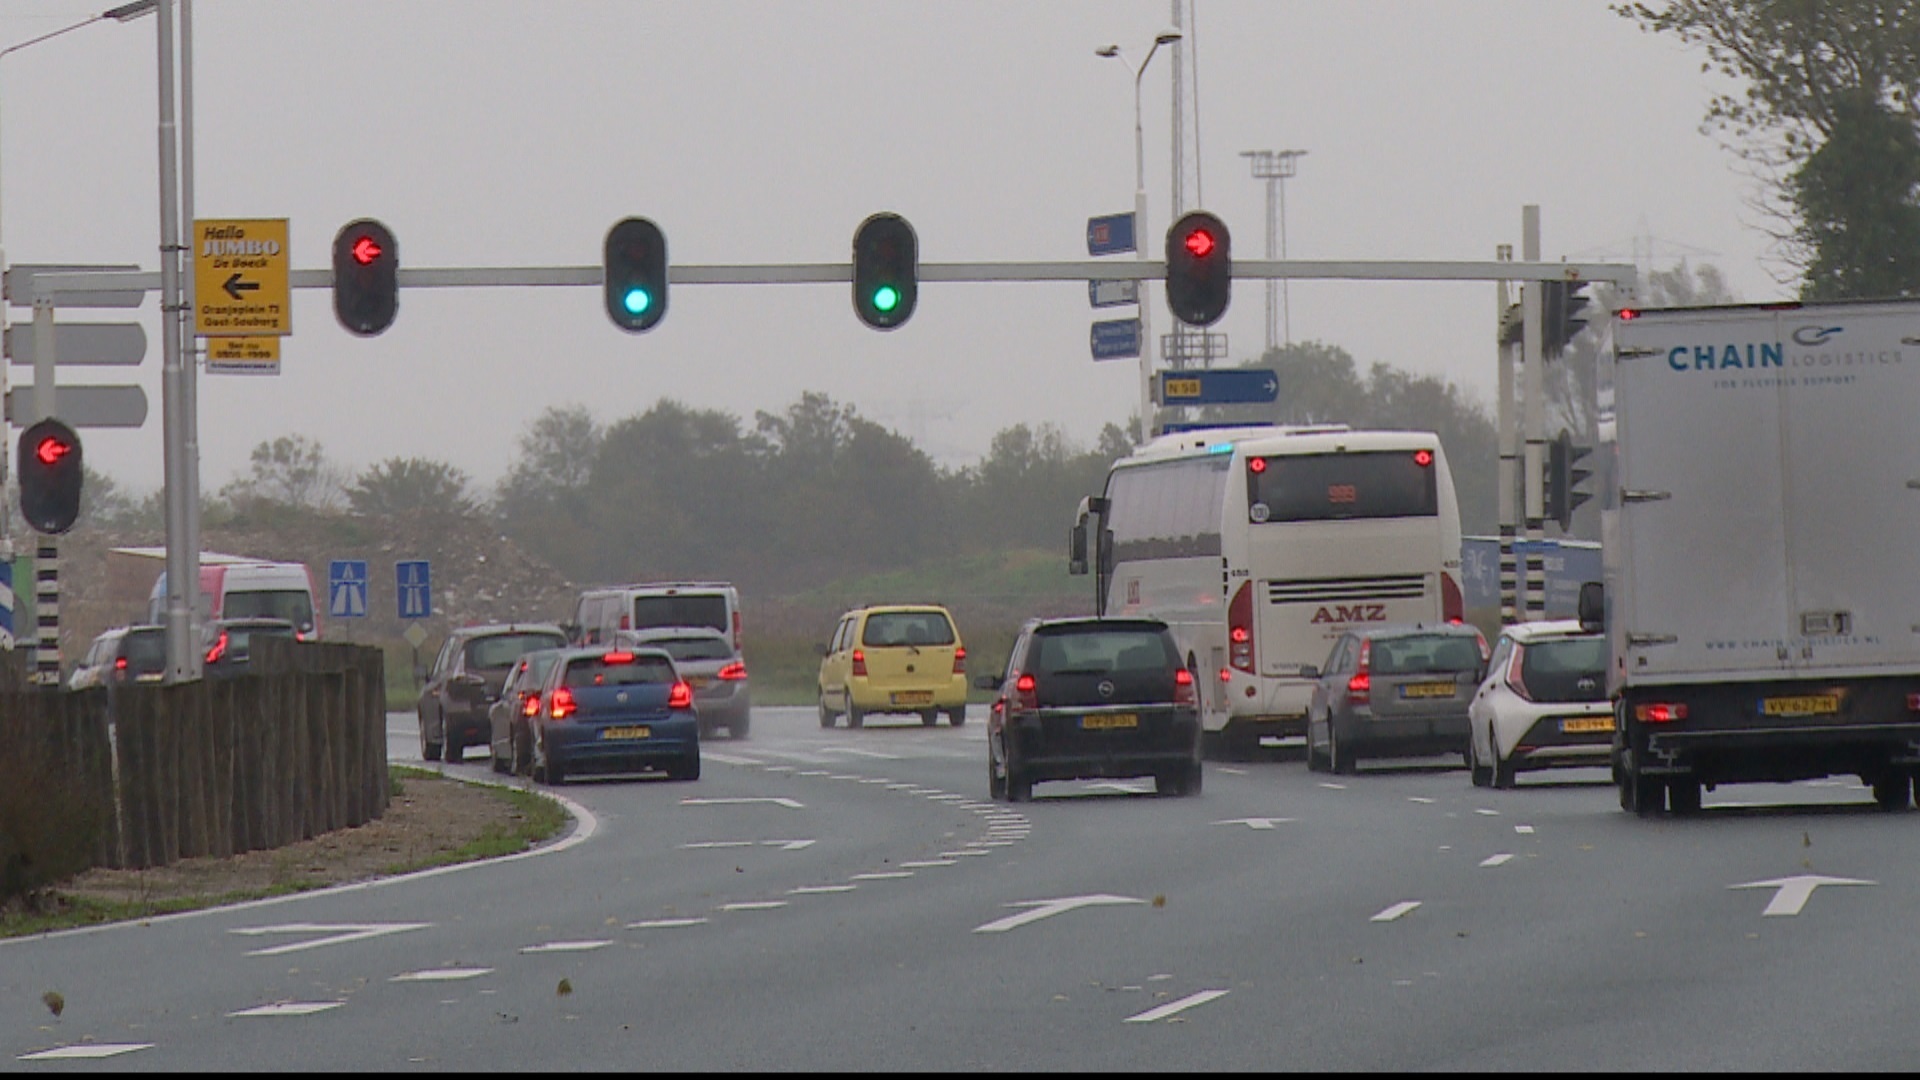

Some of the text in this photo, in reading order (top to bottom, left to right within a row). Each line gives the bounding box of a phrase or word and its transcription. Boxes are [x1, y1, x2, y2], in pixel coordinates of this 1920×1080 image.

[203, 225, 245, 240] Hallo
[202, 240, 280, 257] JUMBO
[1668, 342, 1903, 371] CHAIN LOGISTICS
[1168, 383, 1178, 394] N
[1310, 604, 1387, 624] AMZ
